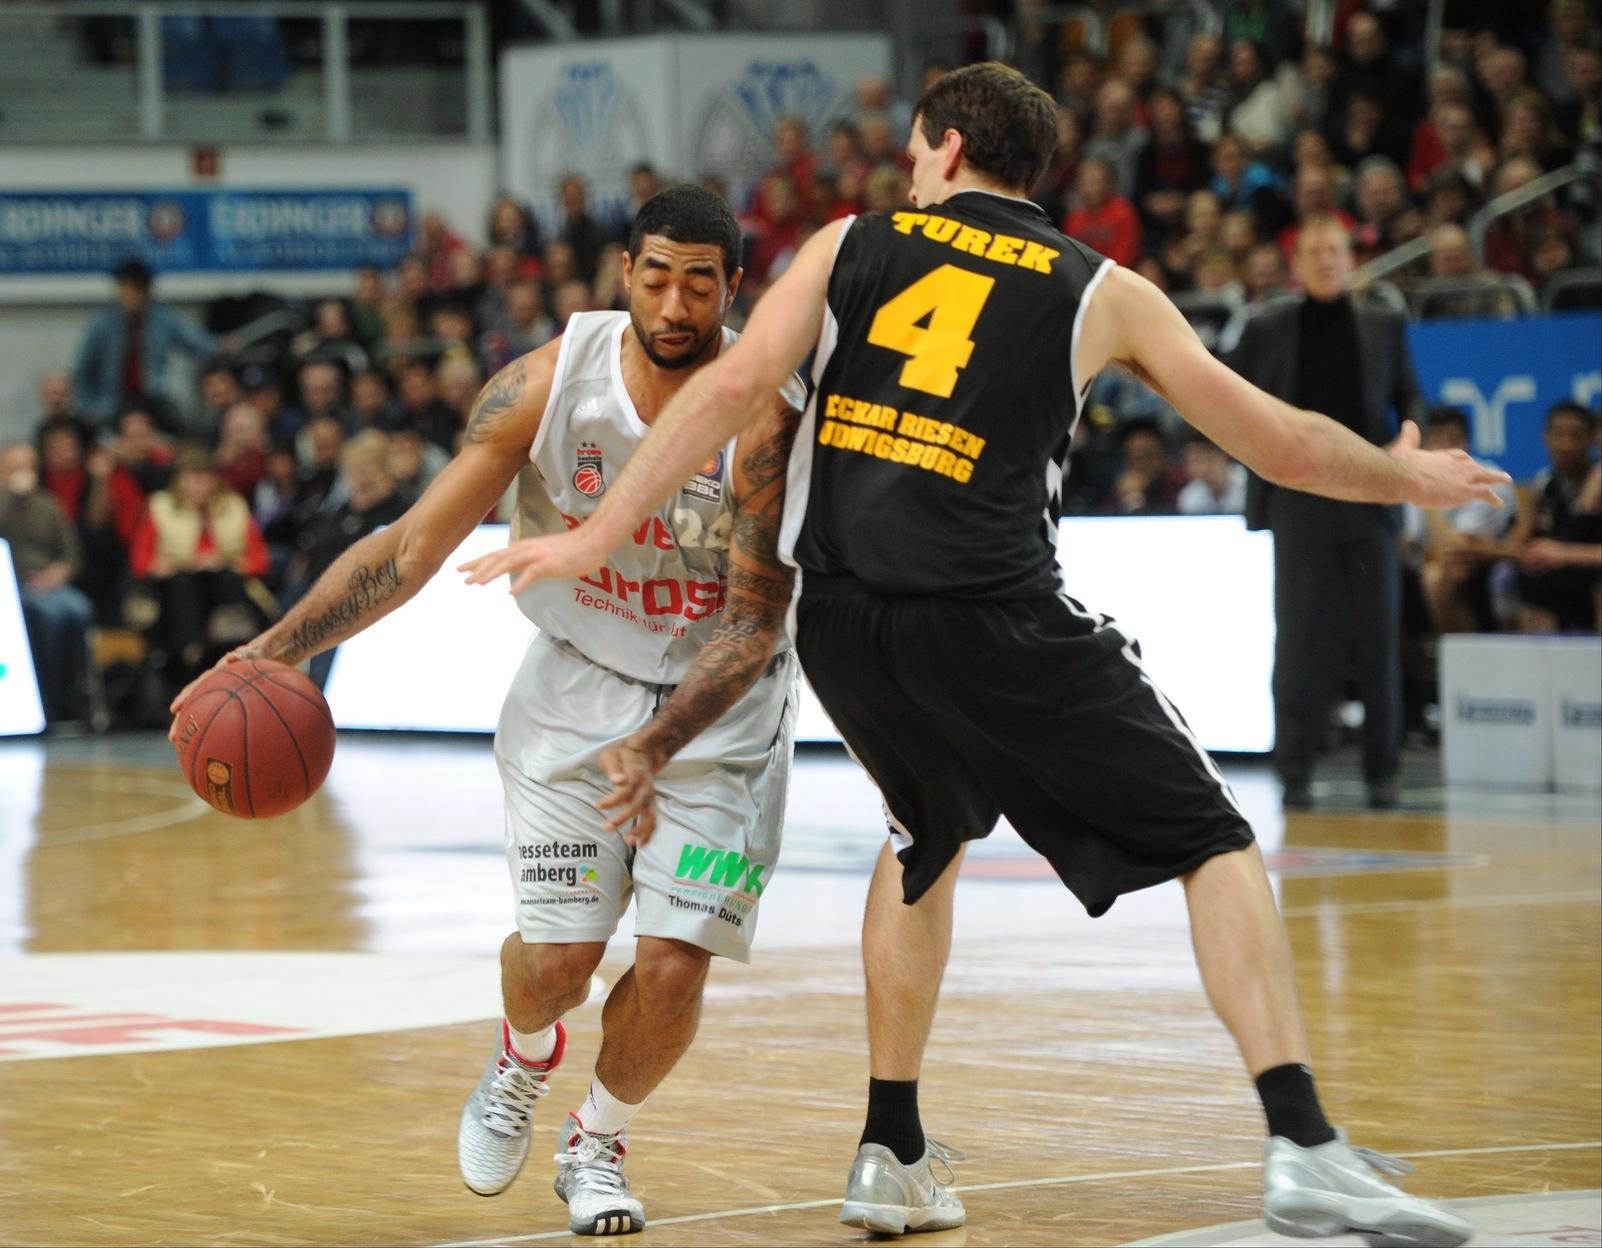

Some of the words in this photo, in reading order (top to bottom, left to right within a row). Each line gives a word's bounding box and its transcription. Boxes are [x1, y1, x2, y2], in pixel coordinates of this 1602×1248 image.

[891, 211, 1060, 274] TUREK
[866, 263, 995, 399] 4
[825, 394, 899, 431] ECKAR
[897, 411, 986, 460] RIESEN
[818, 420, 974, 484] UDWIGSBURG
[684, 480, 720, 499] BBL
[693, 474, 720, 490] EKO
[574, 588, 638, 624] Technik
[519, 841, 598, 859] esseteam
[521, 863, 577, 886] amberg
[674, 844, 765, 898] WWK
[668, 894, 715, 914] Thomas
